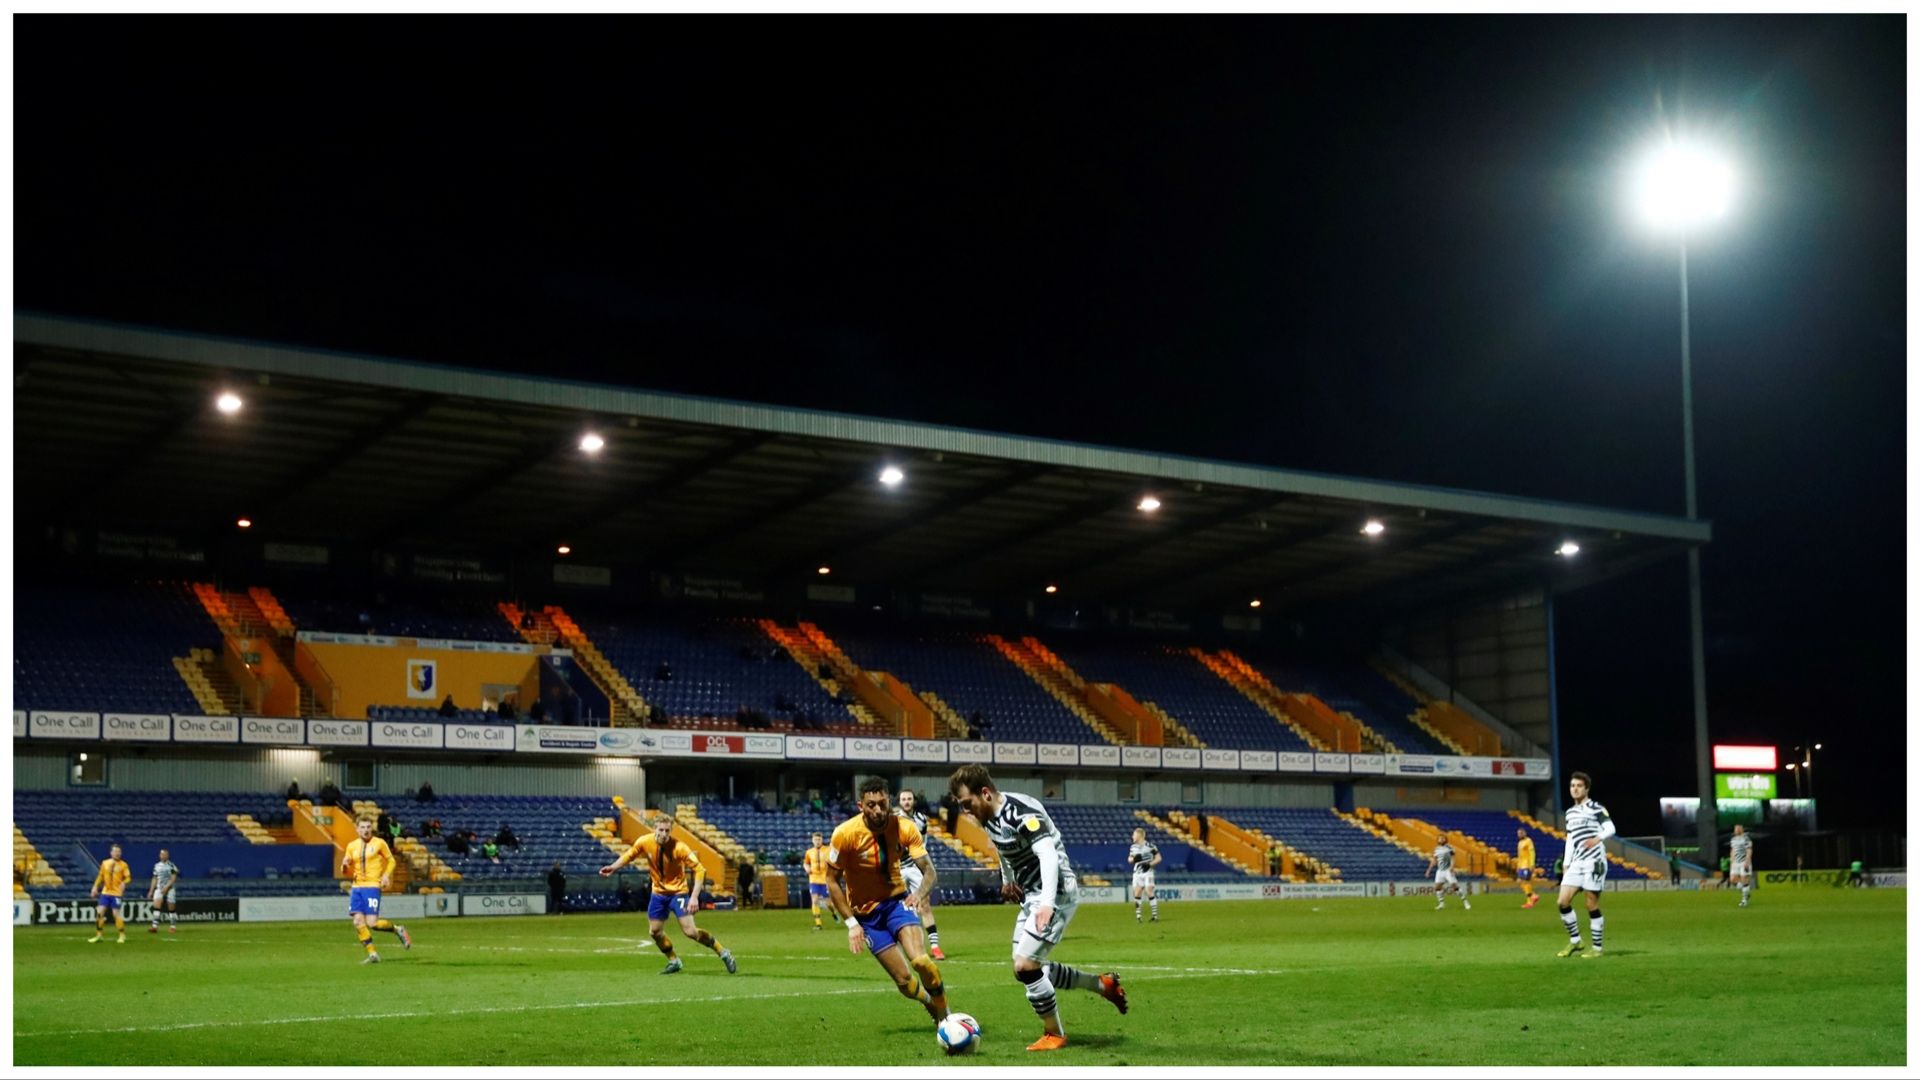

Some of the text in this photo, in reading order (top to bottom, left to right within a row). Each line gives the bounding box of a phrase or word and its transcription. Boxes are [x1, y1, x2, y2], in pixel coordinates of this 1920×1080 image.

[36, 714, 93, 728] One Call
[109, 717, 164, 730] One Call
[180, 719, 232, 732] One Call
[247, 721, 298, 734] One Call
[313, 723, 362, 736] One Call
[383, 724, 432, 738] One Call
[456, 727, 504, 740] One Call
[707, 736, 729, 746] OCL
[794, 740, 836, 750] One Call
[854, 741, 893, 752] One Call
[907, 743, 944, 754] One Call
[953, 744, 988, 754] One Call
[998, 745, 1032, 756] One Call
[1041, 747, 1074, 757] One Call
[1084, 748, 1116, 758] One Call
[1126, 750, 1157, 760] One Call
[1165, 751, 1196, 762] One Call
[1206, 752, 1236, 762] One Call
[1244, 753, 1274, 763] One Call
[1281, 754, 1310, 764] One Call
[1318, 756, 1346, 766] One Call
[1354, 757, 1382, 766] One Call
[1080, 887, 1112, 898] One Call
[368, 898, 378, 908] 10
[482, 896, 528, 908] One Call
[676, 898, 685, 909] 7
[38, 901, 107, 923] Prin
[218, 911, 235, 920] Ltd
